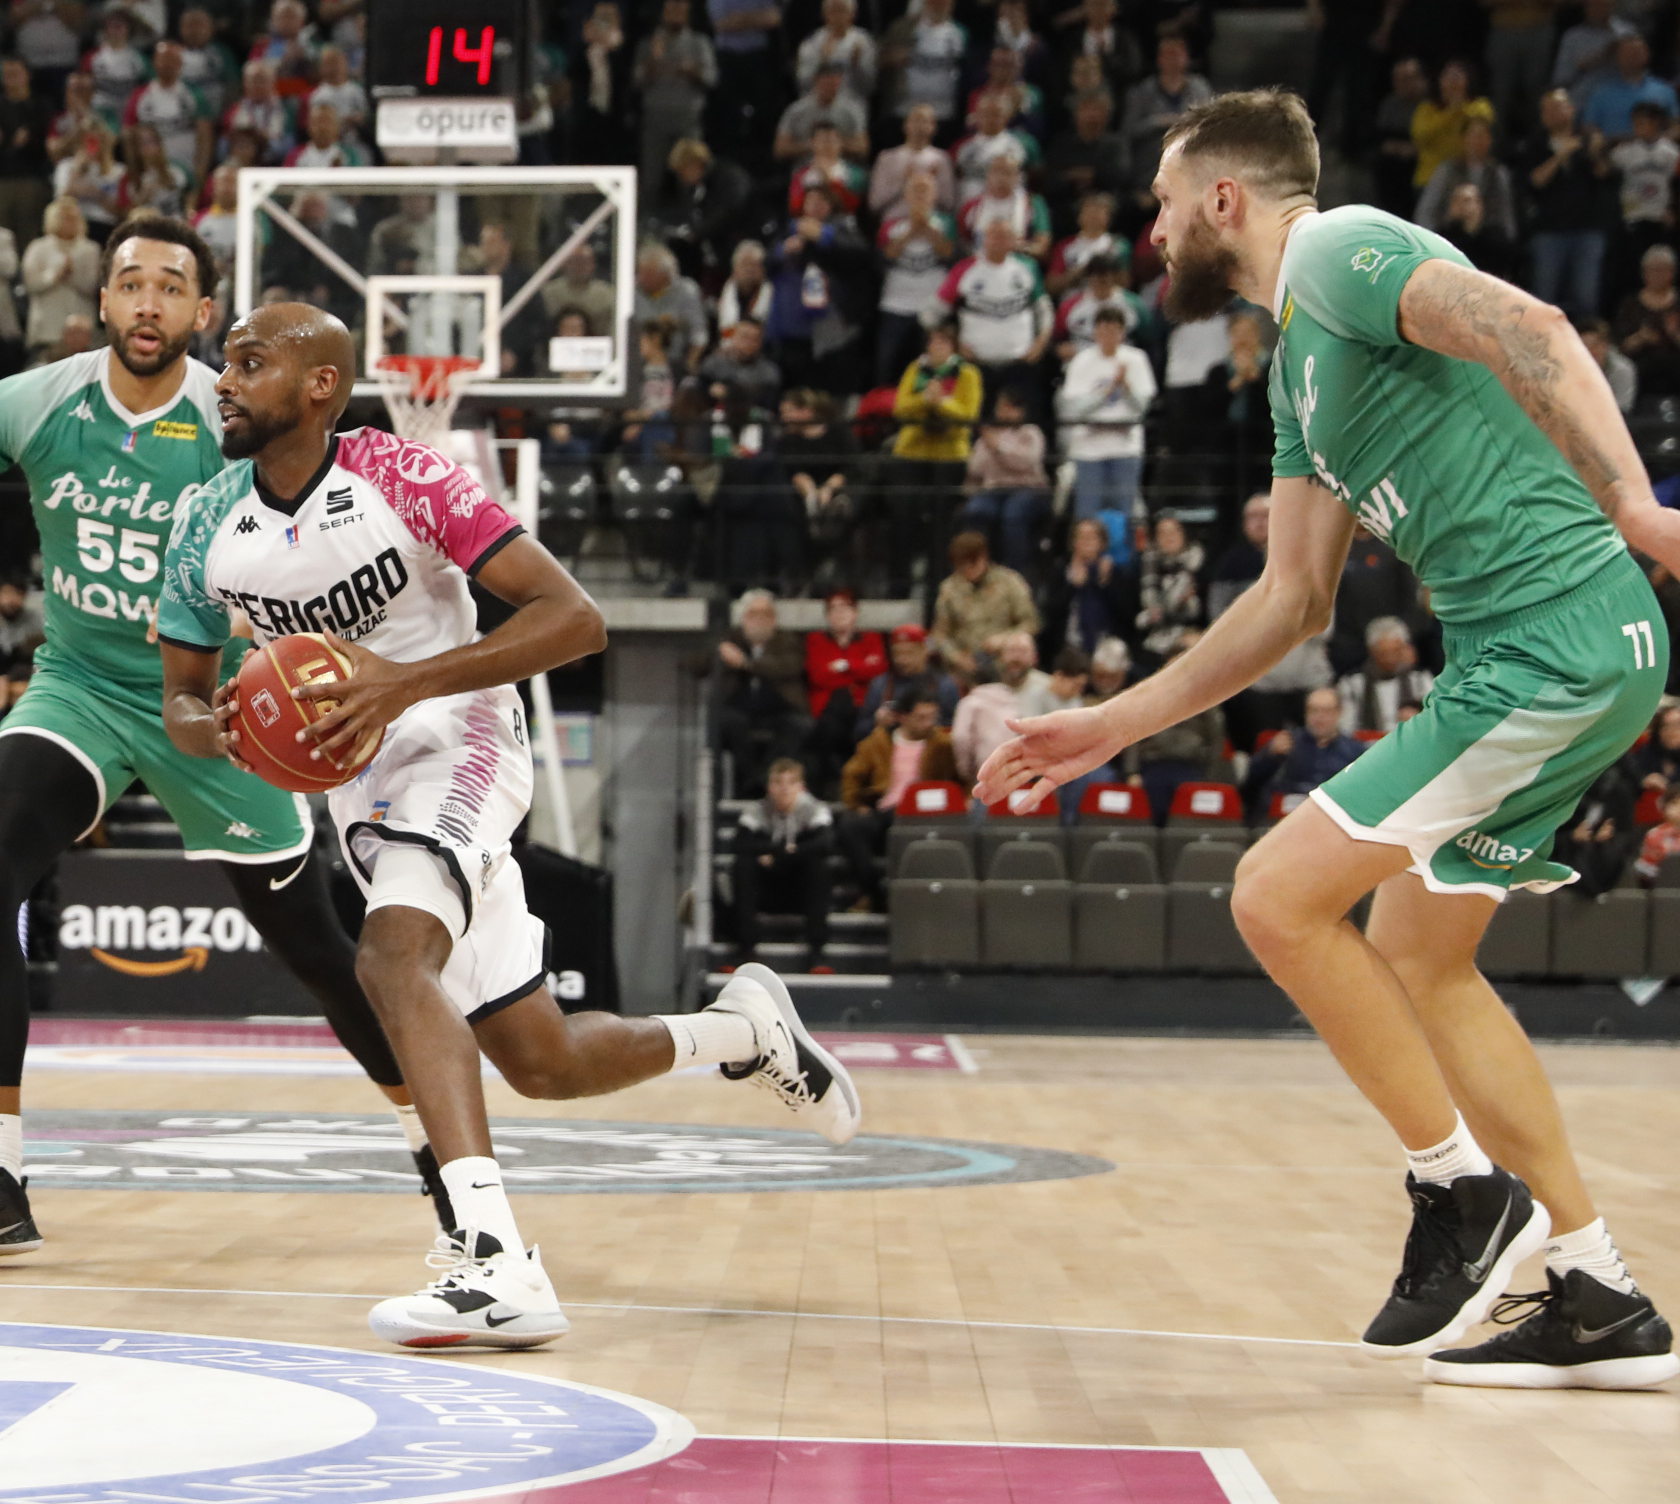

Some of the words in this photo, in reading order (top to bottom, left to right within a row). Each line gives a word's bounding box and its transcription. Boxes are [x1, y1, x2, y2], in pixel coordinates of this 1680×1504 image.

[425, 25, 495, 86] 14
[44, 471, 204, 522] Portel
[98, 464, 133, 488] Le
[319, 512, 365, 532] SEAT
[76, 517, 160, 583] 55
[1621, 620, 1655, 670] 11
